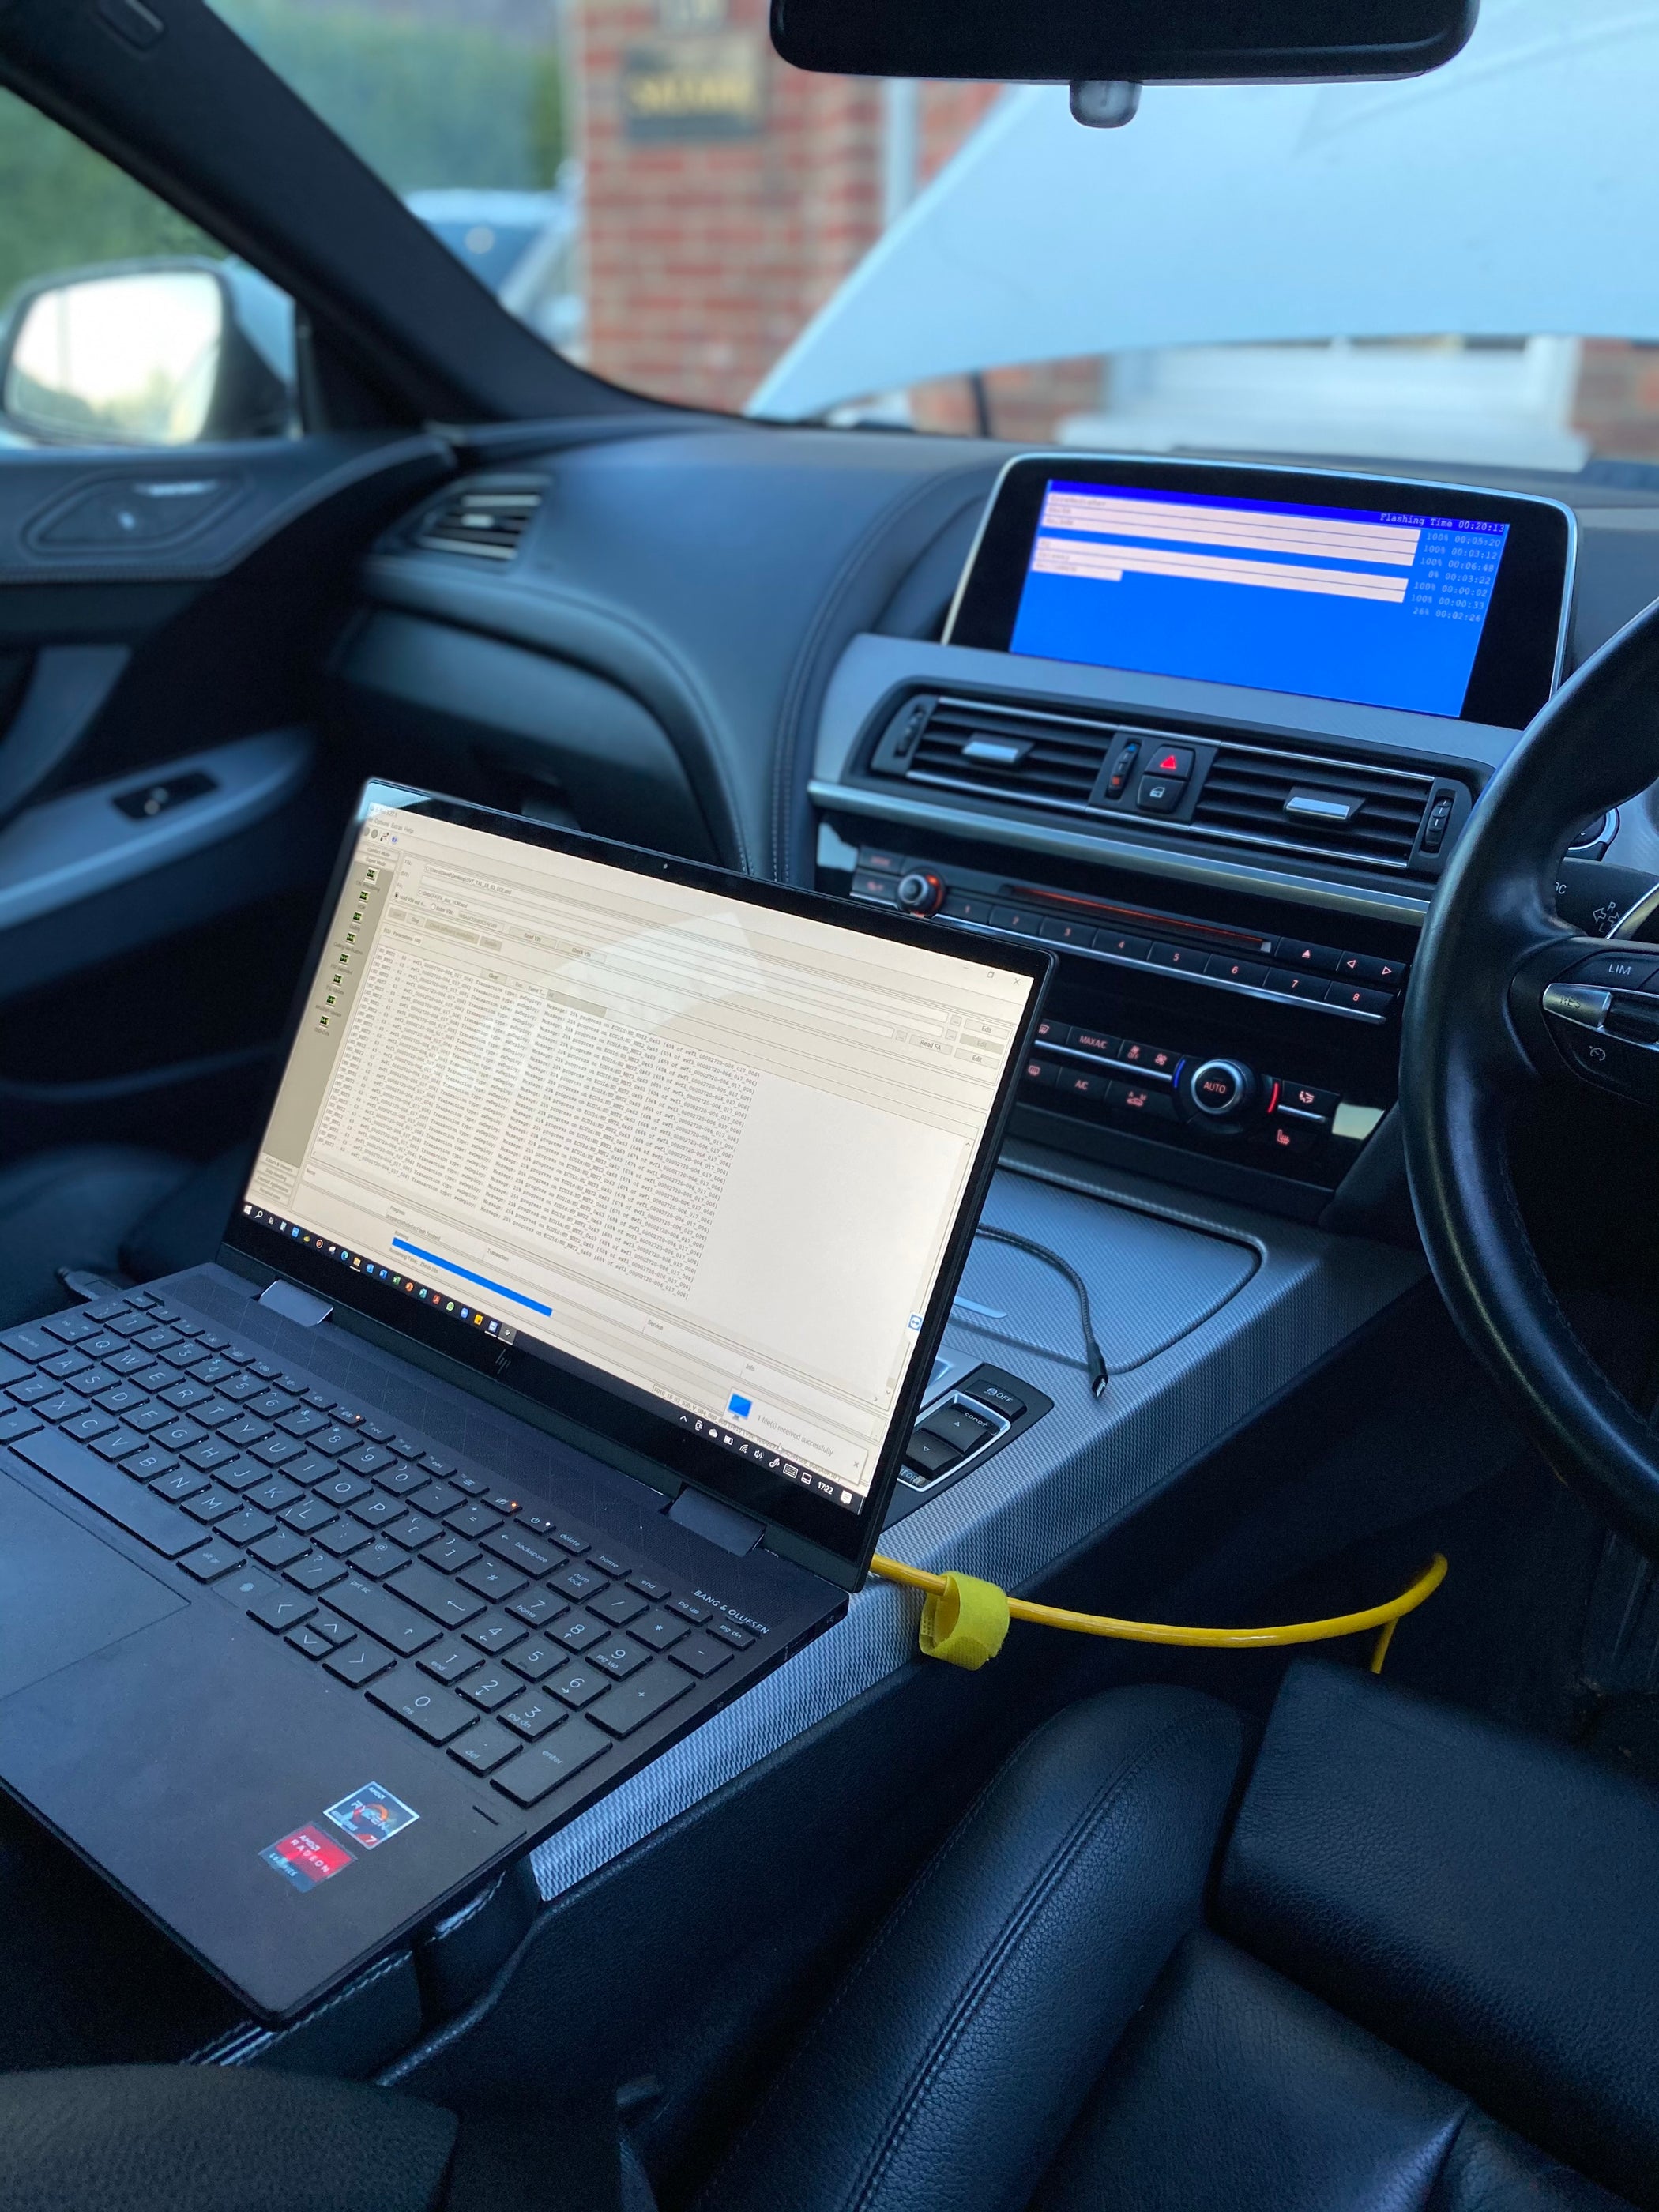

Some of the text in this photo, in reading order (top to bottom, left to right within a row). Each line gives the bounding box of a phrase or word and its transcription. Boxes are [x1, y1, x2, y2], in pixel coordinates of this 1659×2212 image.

[1380, 514, 1424, 525] Flashing
[1459, 521, 1504, 532] 00:20:13
[1607, 901, 1616, 911] R
[1013, 916, 1019, 925] 2
[1608, 964, 1631, 975] LIM
[1560, 996, 1581, 1009] RES
[920, 1040, 934, 1049] Read
[1075, 1080, 1089, 1090] A/C
[1203, 1082, 1226, 1093] AUTO
[61, 1360, 72, 1369] A
[121, 1355, 140, 1364] W
[149, 1372, 165, 1381] E
[25, 1384, 43, 1393] Z
[177, 1390, 193, 1398] R
[996, 1391, 1013, 1402] OFF
[53, 1401, 70, 1410] X
[141, 1410, 158, 1419] F
[82, 1420, 98, 1428] C
[111, 1437, 129, 1446] V
[762, 1416, 777, 1430] file(s)
[777, 1425, 800, 1440] received
[801, 1436, 833, 1457] successfully
[201, 1447, 219, 1458] H
[269, 1443, 286, 1452] U
[139, 1457, 157, 1466] B
[170, 1477, 190, 1488] N
[335, 1483, 351, 1492] O
[264, 1487, 284, 1498] K
[201, 1497, 224, 1510] M
[299, 1509, 311, 1518] L
[560, 1533, 580, 1547] delete
[515, 1542, 548, 1563] backspace
[600, 1556, 619, 1568] home
[568, 1577, 582, 1587] lock
[574, 1573, 589, 1583] num
[641, 1580, 656, 1589] end
[516, 1604, 536, 1618] home
[694, 1590, 720, 1607] BANG
[728, 1609, 770, 1635] OLUFSEN
[489, 1627, 502, 1636] 4
[570, 1624, 585, 1634] 8
[720, 1624, 730, 1633] pg
[446, 1654, 458, 1663] 1
[528, 1651, 544, 1661] 5
[611, 1650, 626, 1659] 9
[431, 1661, 447, 1671] end
[481, 1680, 498, 1691] 2
[569, 1677, 585, 1688] 6
[415, 1696, 431, 1706] 0
[525, 1706, 542, 1717] 3
[542, 1750, 563, 1764] enter
[291, 1839, 330, 1872] RADEON
